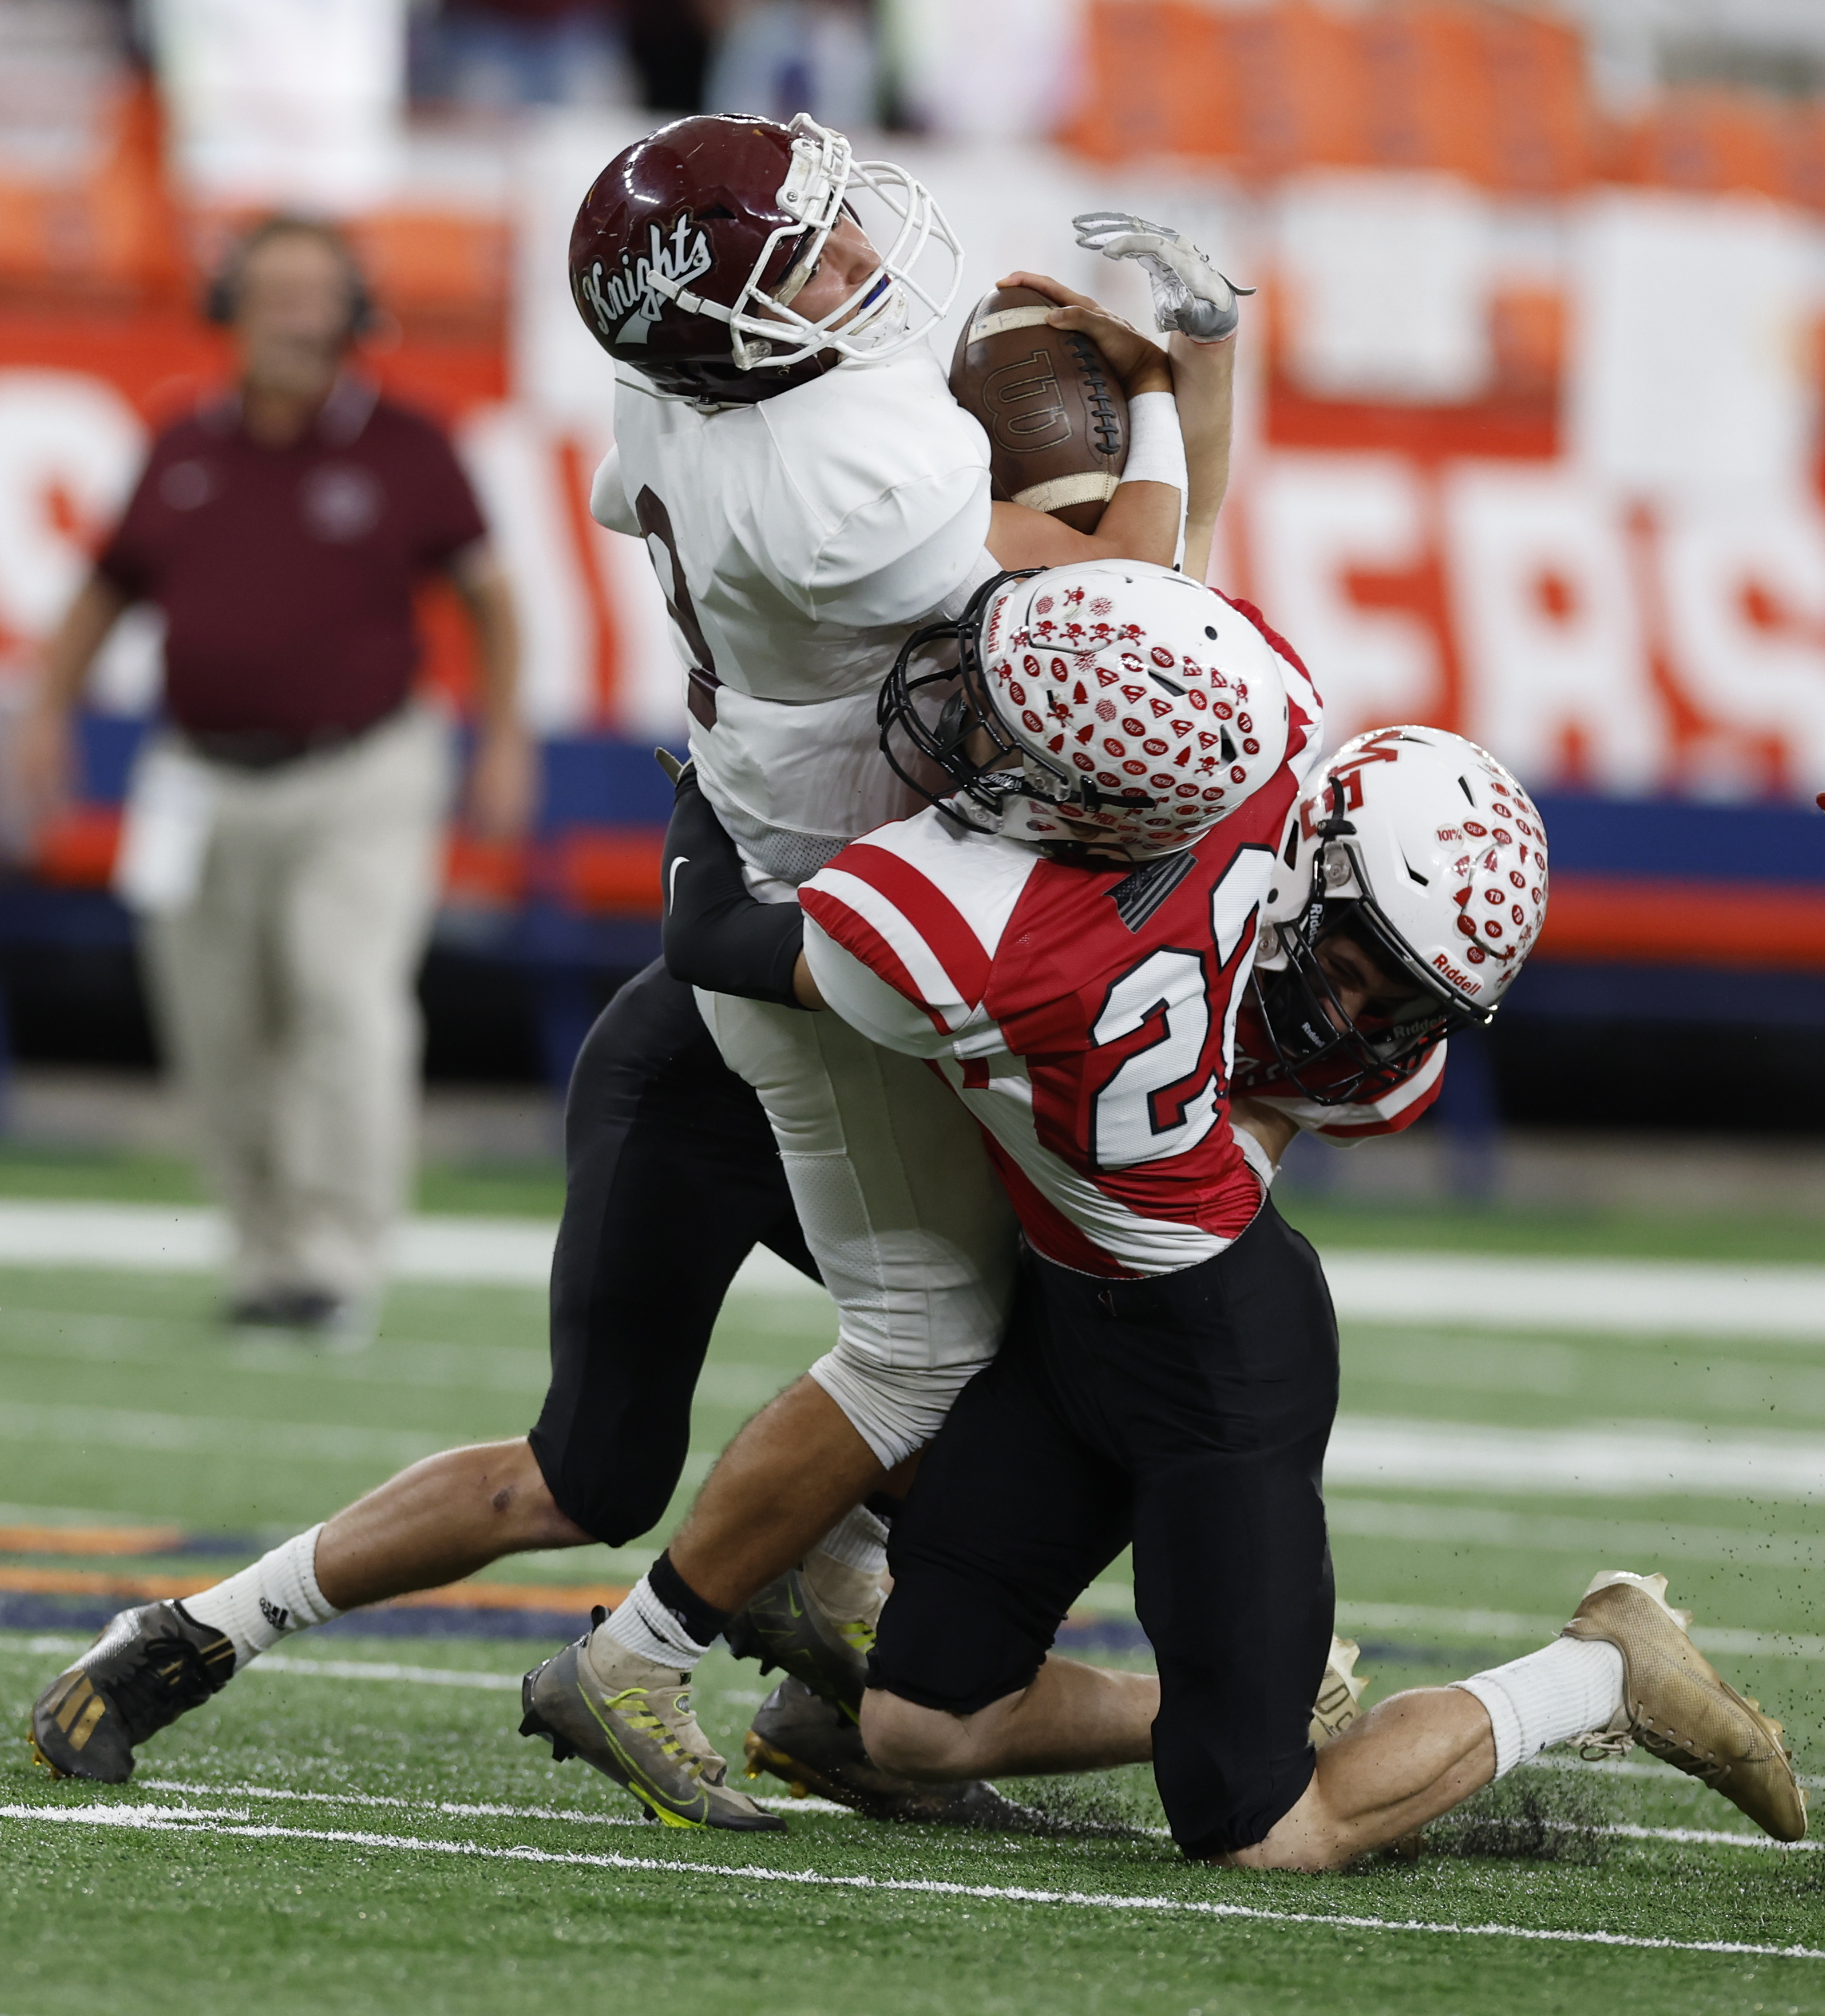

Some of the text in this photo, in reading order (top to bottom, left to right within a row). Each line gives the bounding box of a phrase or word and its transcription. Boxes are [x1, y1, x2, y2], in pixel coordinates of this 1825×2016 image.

[582, 213, 712, 336] Knights
[1025, 658, 1038, 674] TD
[1052, 662, 1065, 677] INT
[1010, 684, 1024, 702] DEF
[1189, 690, 1206, 708] SACK
[1214, 704, 1231, 718] SACK
[1125, 719, 1144, 734] DEF
[1239, 715, 1251, 729] TD
[1105, 740, 1123, 755] SACK
[1145, 740, 1167, 753] TACKLE
[1245, 740, 1258, 752] INT
[1075, 754, 1092, 769] DEF
[1126, 762, 1144, 773] SACK
[985, 772, 1023, 789] Riddell
[1099, 773, 1118, 785] DEF
[1232, 768, 1244, 781] INT
[1496, 807, 1509, 817] TD
[1466, 824, 1484, 835] DEF
[1519, 821, 1529, 833] TD
[1436, 828, 1463, 841] 101%
[1513, 873, 1523, 887] TD
[1489, 891, 1501, 902] TD
[1513, 908, 1523, 922] TD
[1488, 923, 1500, 935] INT
[1469, 948, 1484, 961] DEF
[1432, 952, 1482, 996] Riddell
